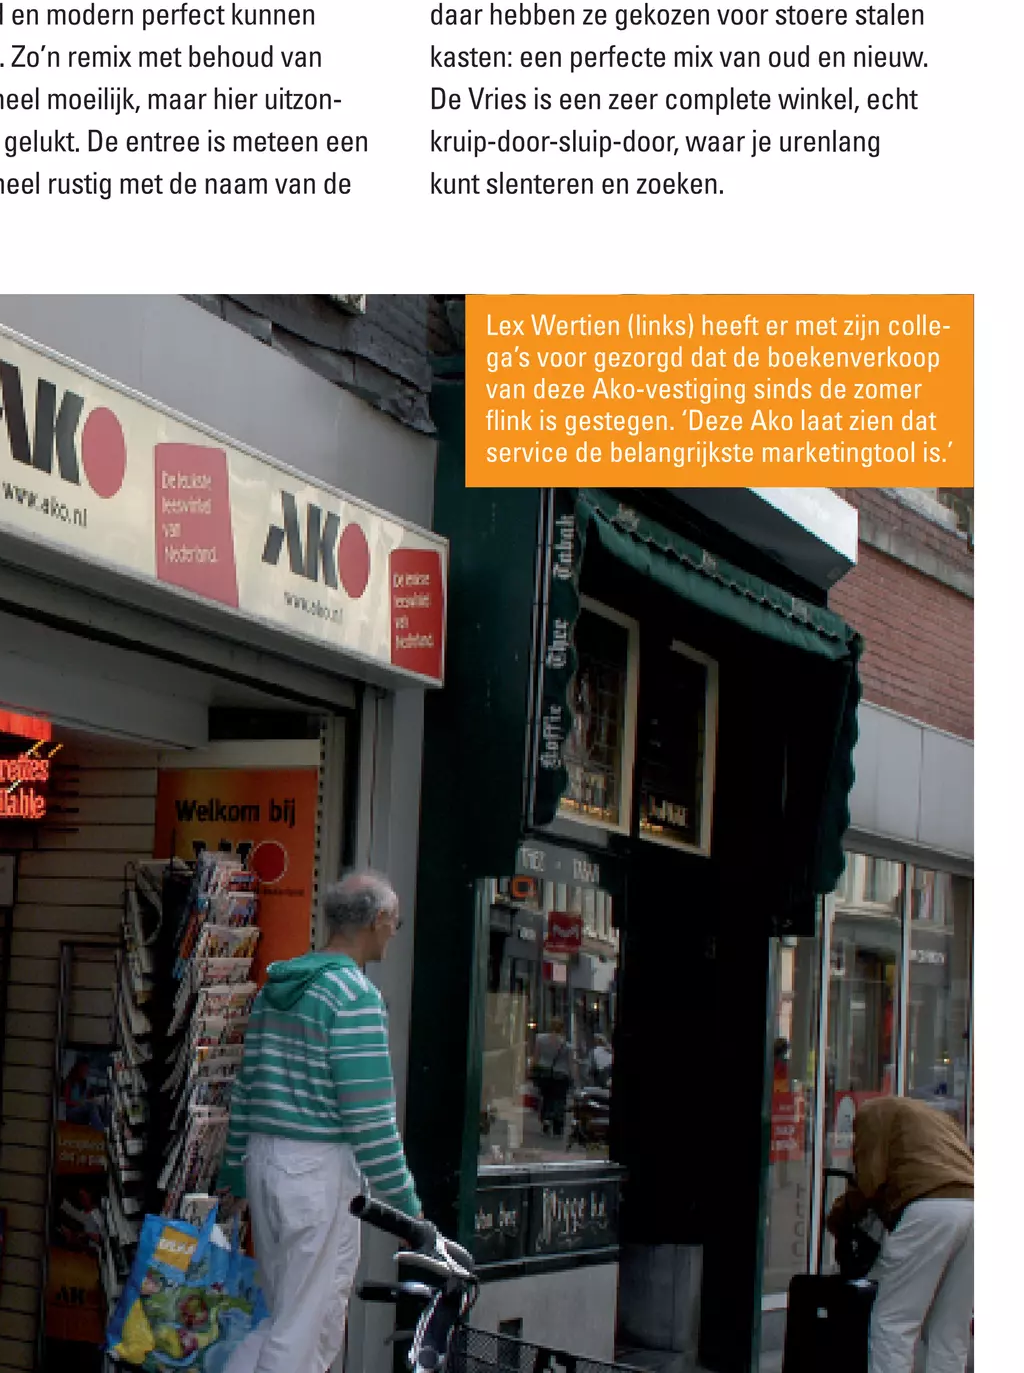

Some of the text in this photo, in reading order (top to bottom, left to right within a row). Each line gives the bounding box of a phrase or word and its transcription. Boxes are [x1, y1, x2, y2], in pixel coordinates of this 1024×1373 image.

[430, 171, 724, 195] kunt slenteren en zoeken.
[487, 313, 951, 341] Lex Wertien (links) heeft er met zijn colle-
[536, 351, 587, 368] voor
[593, 345, 683, 373] gezorgd
[691, 345, 727, 368] dat
[733, 345, 760, 368] de
[768, 345, 940, 373] boekenverkoop
[485, 377, 923, 405] van deze Ako-vestiging sinds de zomer
[485, 409, 533, 431] flink
[539, 409, 557, 431] is
[564, 411, 675, 437] gestegen.
[750, 409, 793, 431] Ako
[801, 408, 843, 431] laat
[849, 409, 893, 431] zien
[901, 409, 937, 431] dat
[486, 441, 568, 463] service
[575, 440, 602, 463] de
[610, 440, 754, 468] belangrijkste
[762, 440, 915, 468] marketingtool
[2, 481, 87, 527] www.ako.nl
[175, 797, 296, 829] Welkom bij
